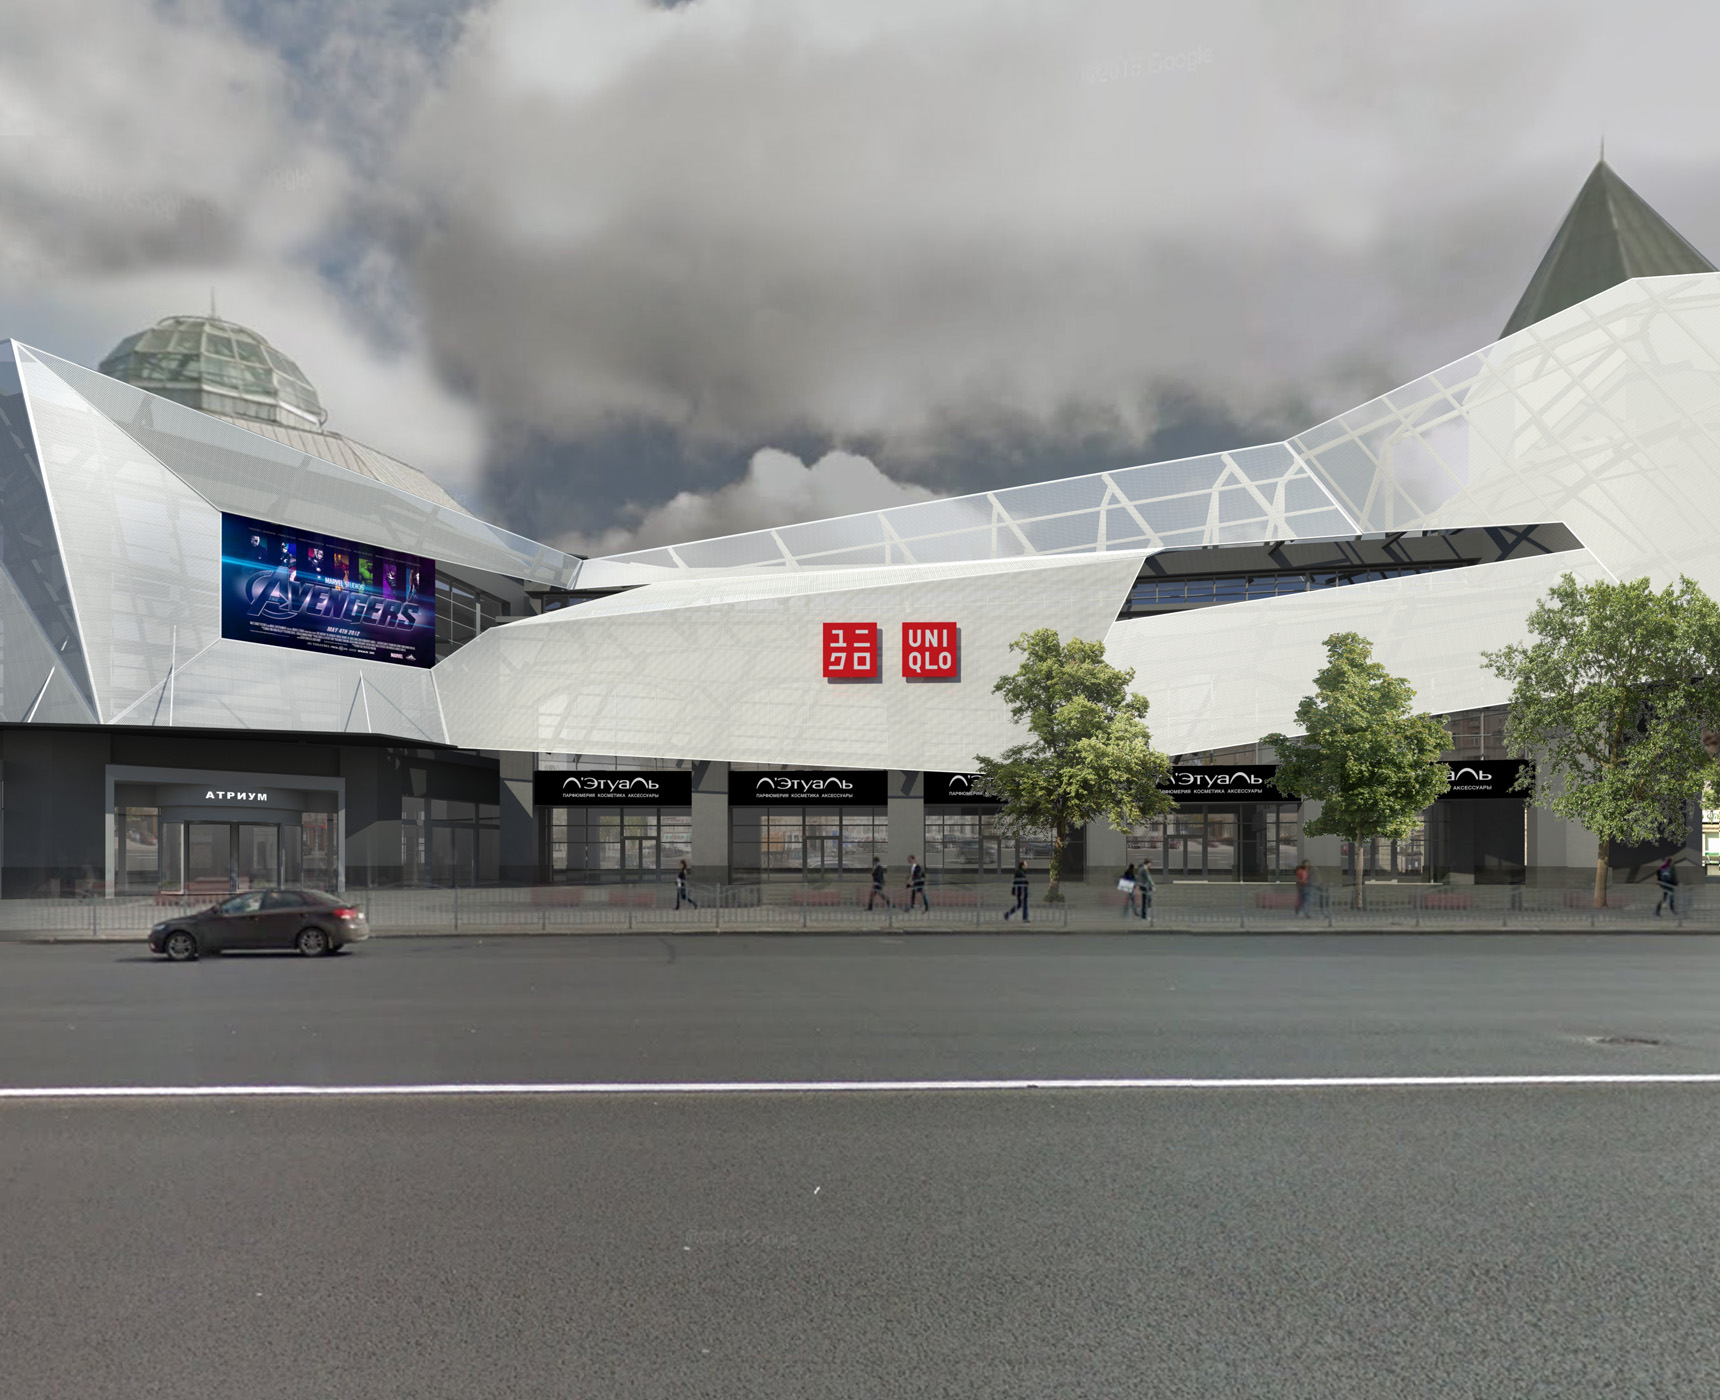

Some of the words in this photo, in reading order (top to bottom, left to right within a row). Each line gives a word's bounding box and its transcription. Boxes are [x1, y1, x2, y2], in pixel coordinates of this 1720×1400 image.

[324, 577, 343, 587] MARVEL
[344, 580, 366, 591] STUDIOS
[245, 566, 420, 632] AVENGERS
[205, 791, 268, 801] АТРИУМ
